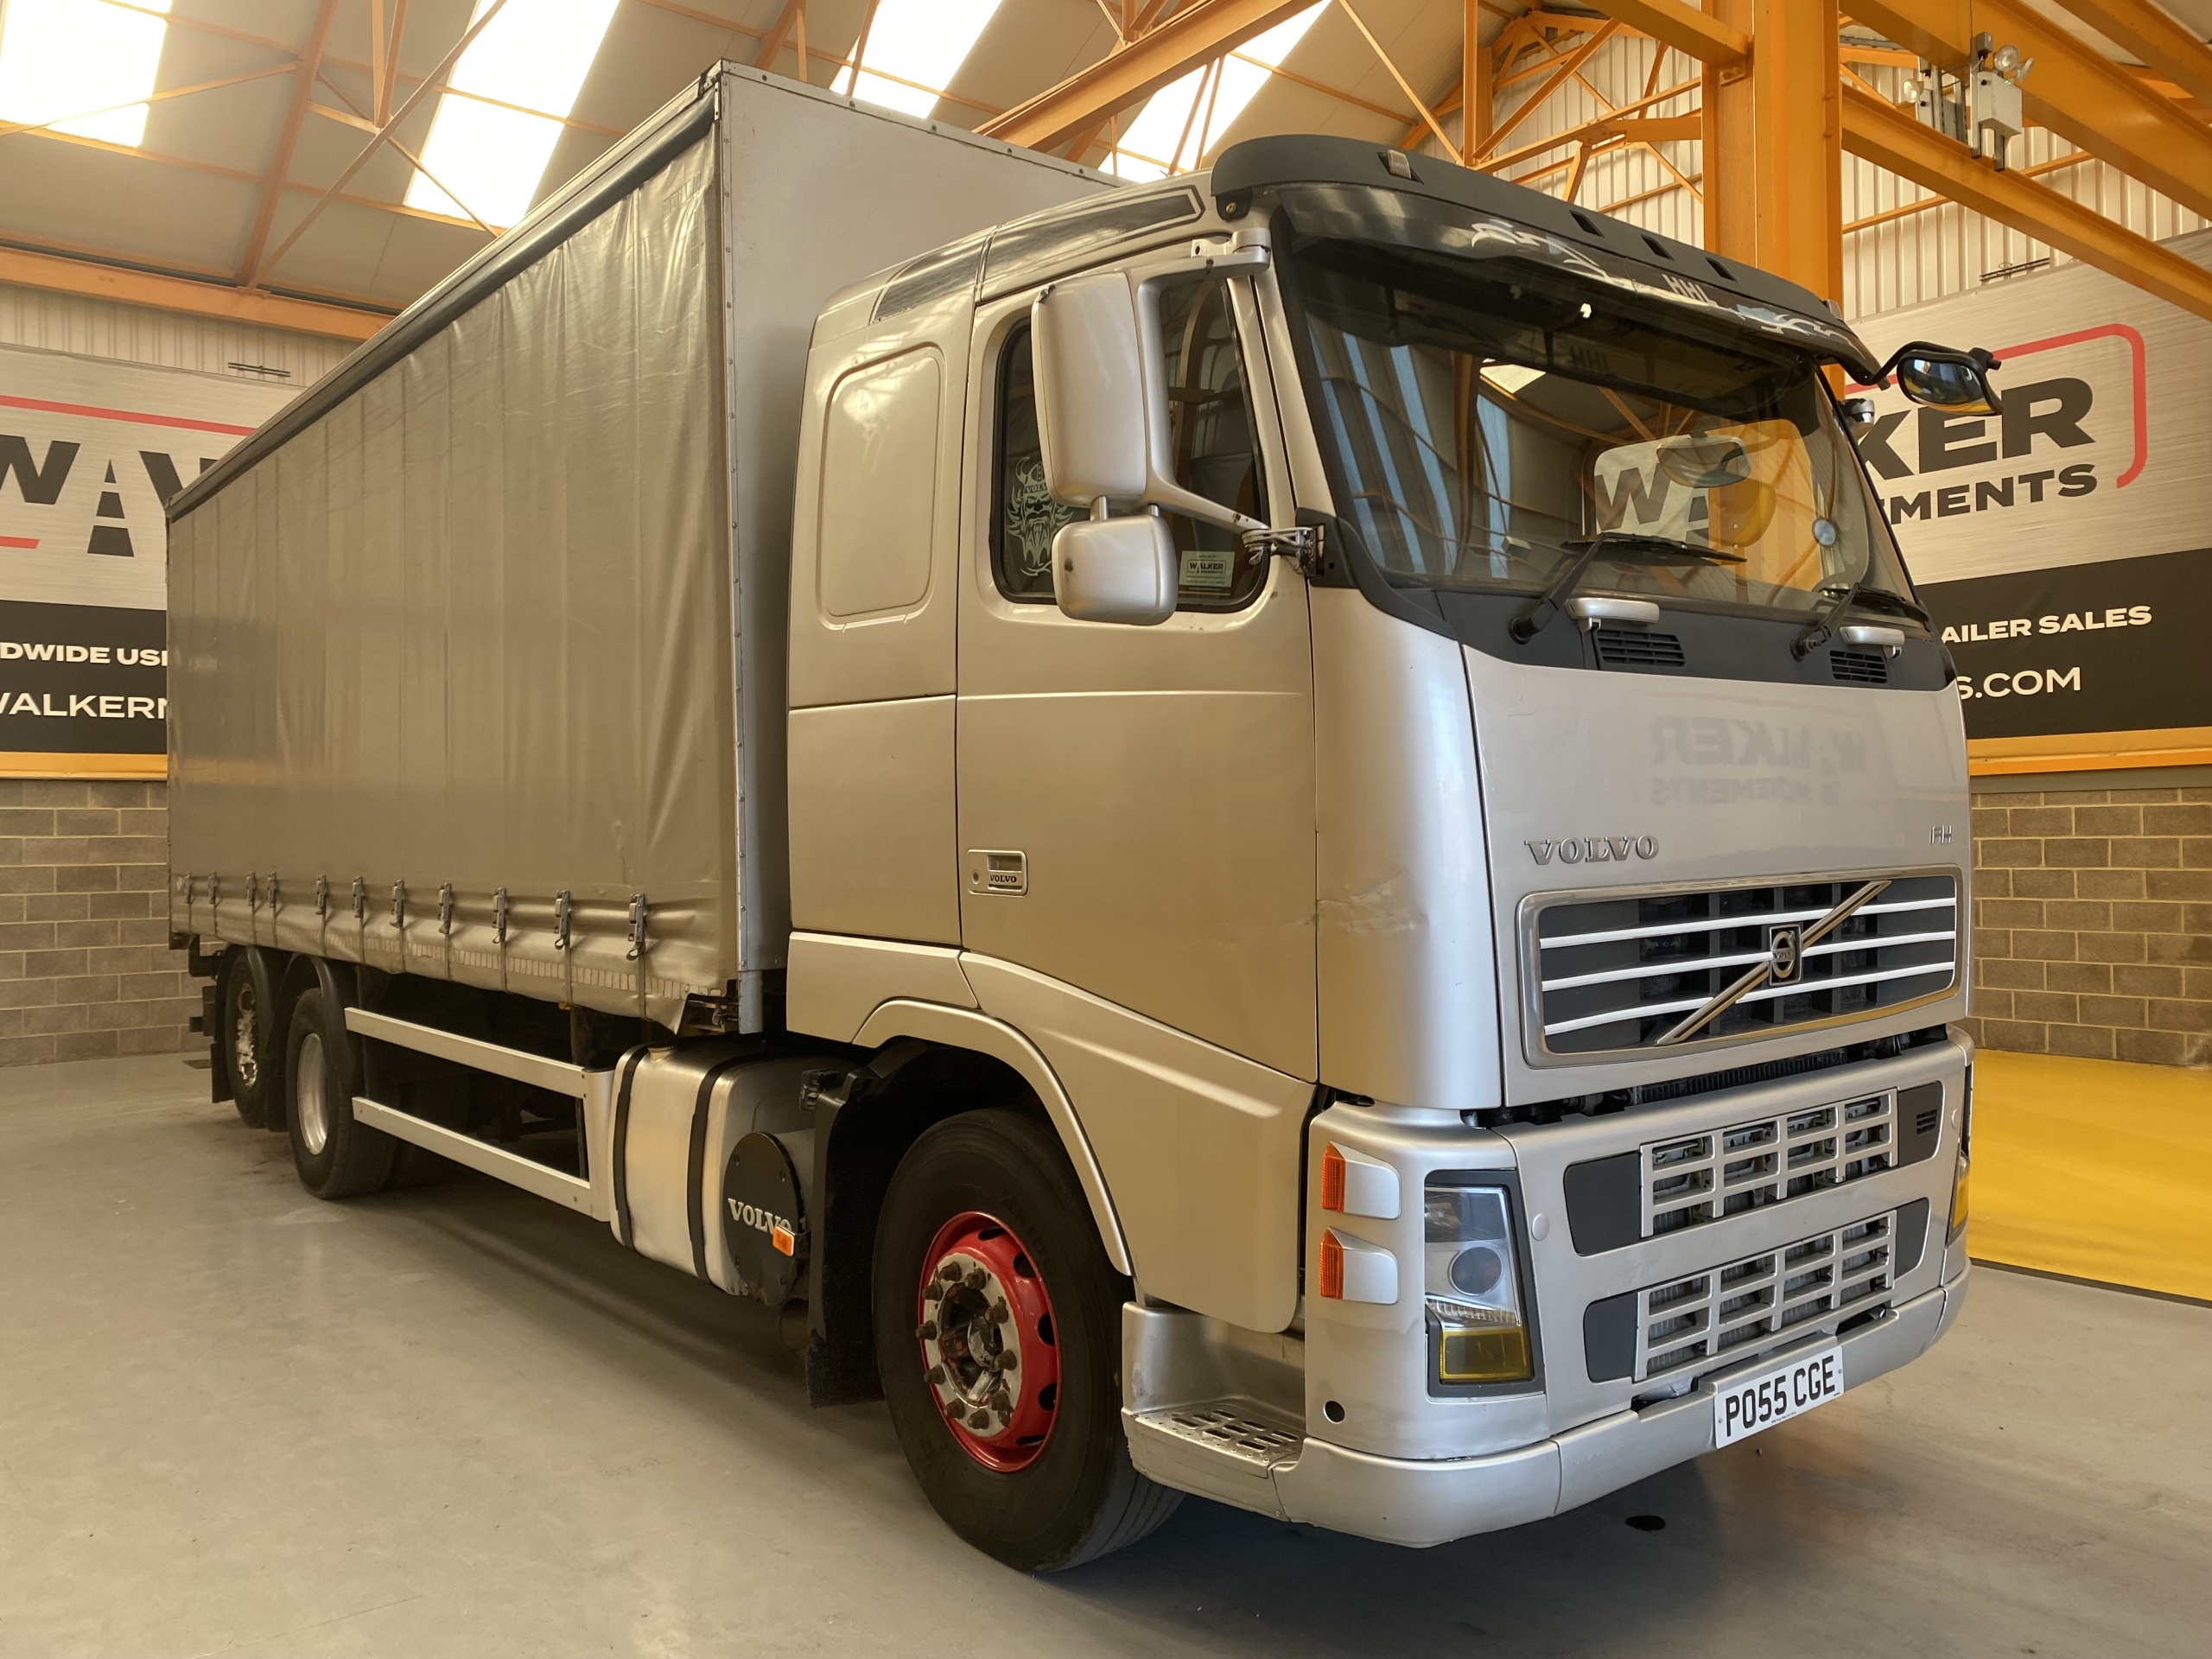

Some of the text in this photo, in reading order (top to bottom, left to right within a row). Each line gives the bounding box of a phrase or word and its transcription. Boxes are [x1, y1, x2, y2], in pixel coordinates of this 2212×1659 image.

[1878, 463, 2098, 524] MENTS
[1189, 563, 1224, 574] WALKER
[1941, 605, 2152, 644] AILER SALES
[0, 642, 168, 667] DWIDE US
[1956, 667, 2082, 701] S.COM
[1524, 835, 1660, 865] VOLVO
[989, 874, 1017, 883] VOLVO
[1726, 1355, 1836, 1438] PO55 CGE
